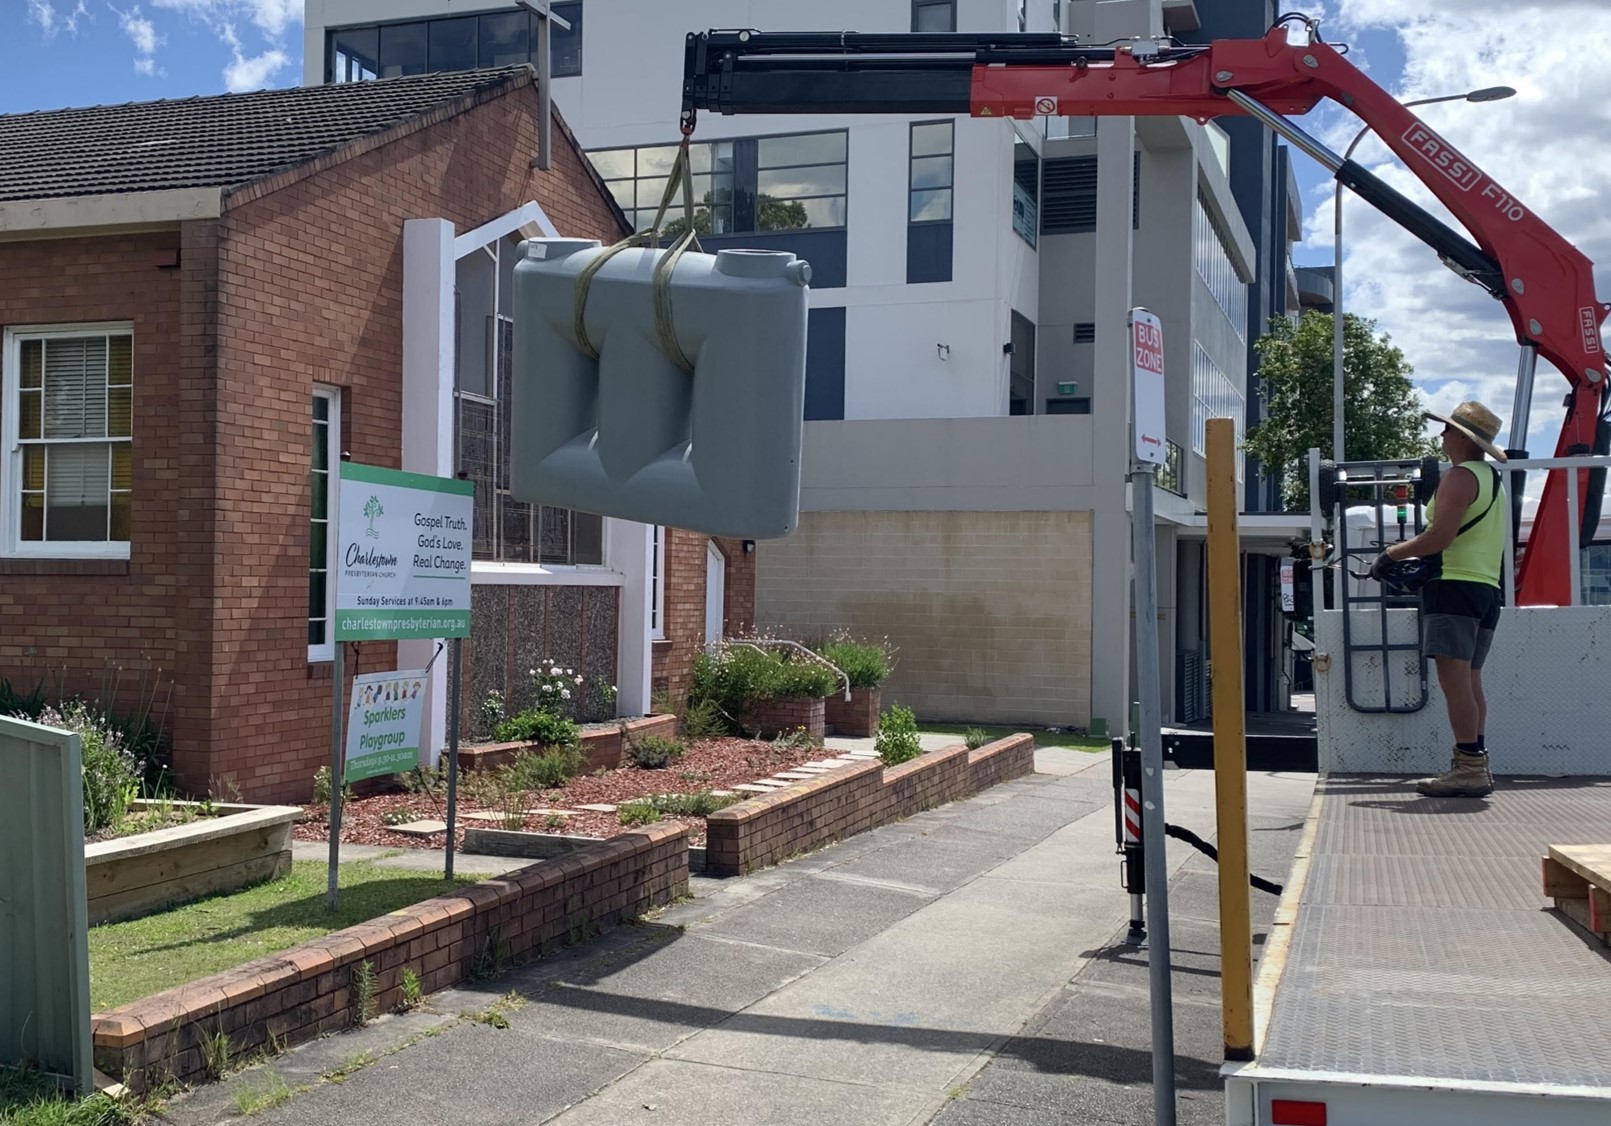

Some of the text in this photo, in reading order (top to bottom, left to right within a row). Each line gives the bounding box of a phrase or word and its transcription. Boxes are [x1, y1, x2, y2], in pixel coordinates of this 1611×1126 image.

[1410, 130, 1524, 221] FASSI F110
[1138, 324, 1159, 348] BUS
[1582, 310, 1597, 350] FASSI
[1136, 347, 1162, 373] ZONE
[414, 512, 467, 531] Gospel Truth.
[417, 534, 463, 551] God's Love.
[345, 542, 398, 569] Charlestown
[413, 554, 467, 574] Real Change.
[345, 570, 378, 578] PRESBYTERIAN
[357, 595, 380, 608] Sunday
[381, 596, 406, 606] Services
[407, 597, 414, 606] at
[436, 596, 441, 606] &
[441, 597, 453, 608] 6pm
[341, 616, 466, 632] charlestownpresbyterian.org.au
[363, 706, 406, 728] Sparklers
[360, 731, 405, 751] Playgroup
